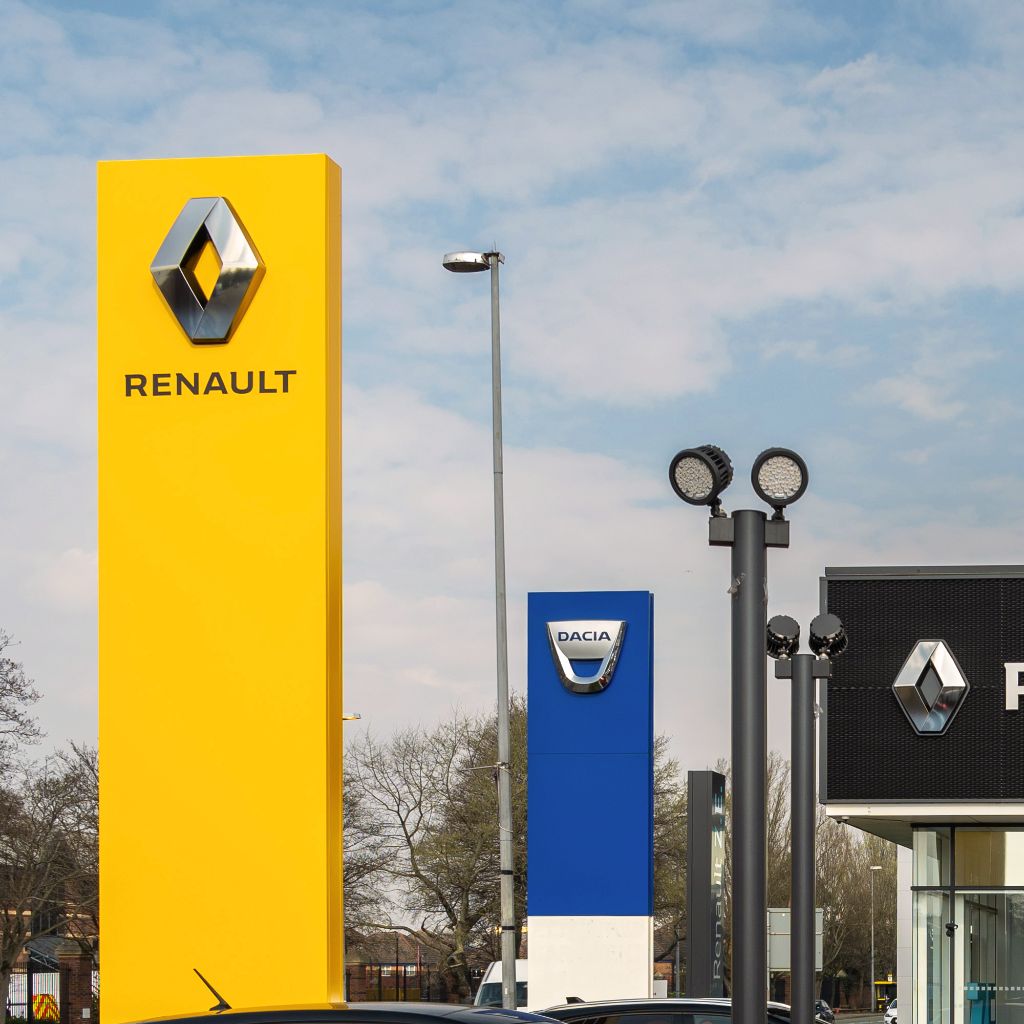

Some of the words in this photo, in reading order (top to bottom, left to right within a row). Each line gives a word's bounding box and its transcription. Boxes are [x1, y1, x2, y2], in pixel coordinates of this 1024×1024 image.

[124, 370, 297, 397] RENAULT
[558, 631, 611, 641] DACIA
[713, 858, 722, 979] Renault
